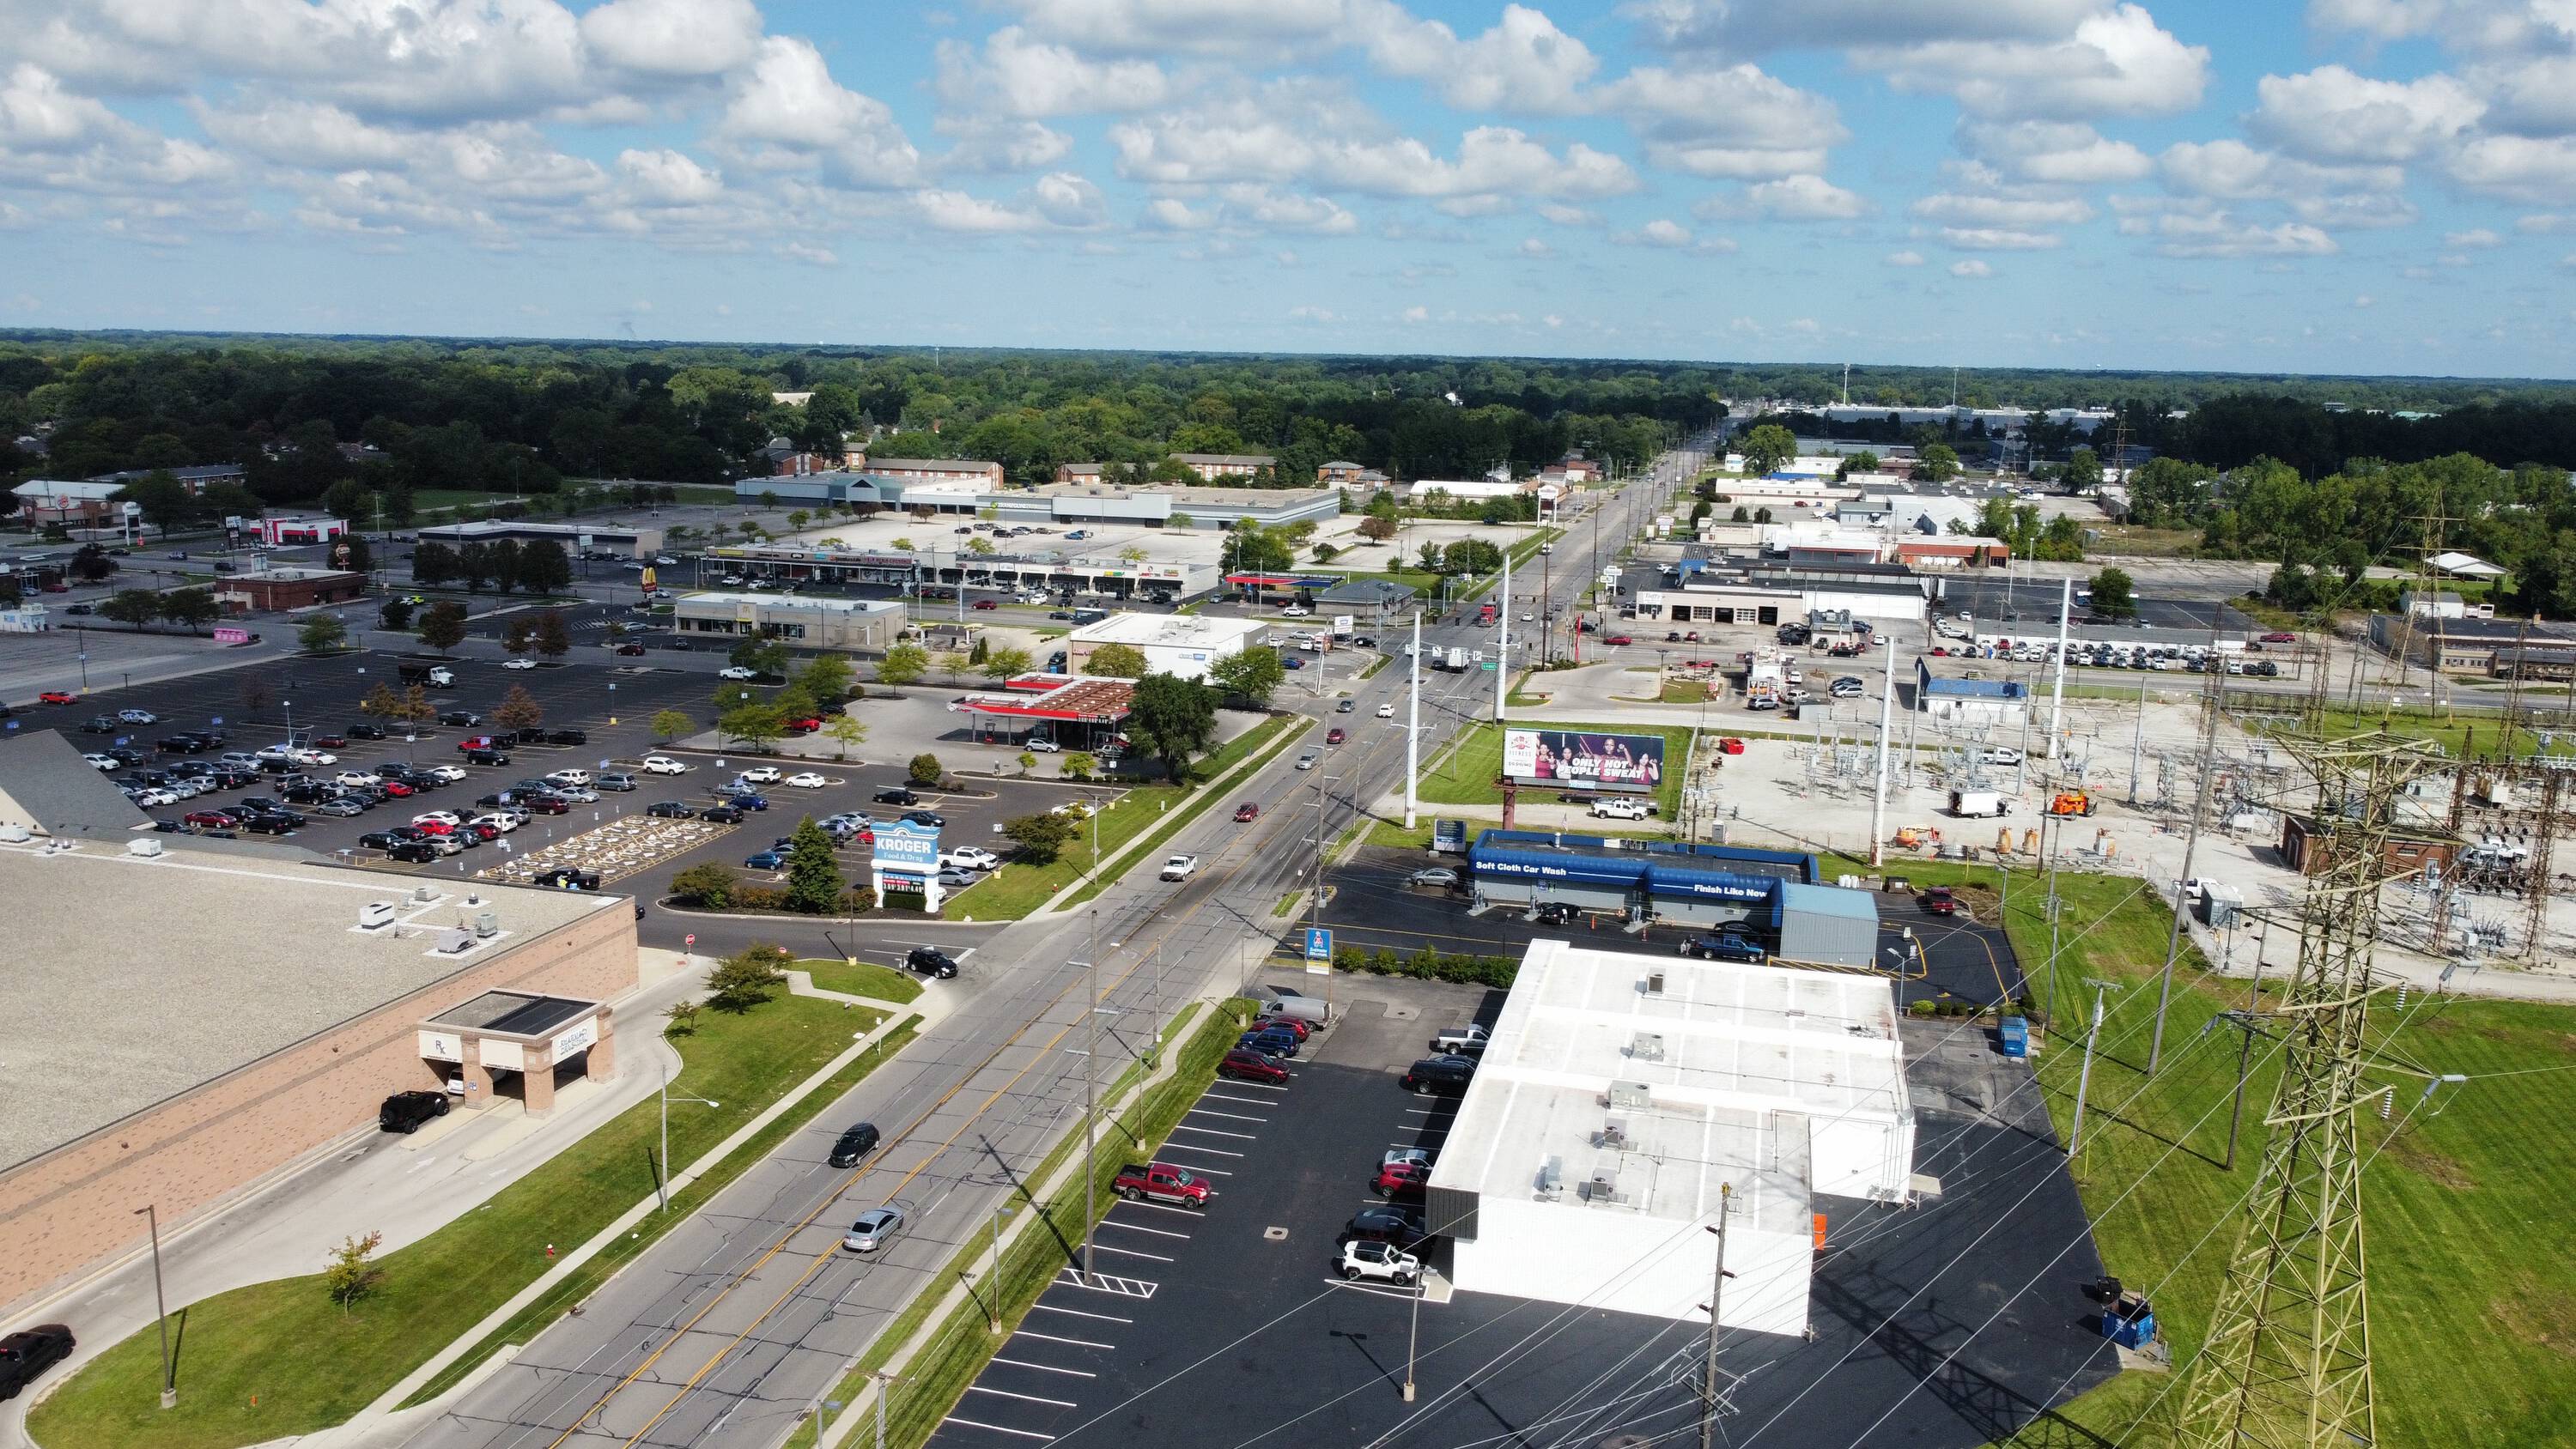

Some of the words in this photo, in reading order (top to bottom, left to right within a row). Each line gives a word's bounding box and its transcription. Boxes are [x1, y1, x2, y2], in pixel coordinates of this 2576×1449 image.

[1572, 757, 1601, 767] ONLY
[1604, 759, 1628, 769] HOT
[1558, 765, 1601, 776] PEOPLE
[1603, 768, 1643, 779] SWEAT
[876, 837, 931, 853] KROGER
[907, 853, 923, 863] Drug
[1475, 861, 1495, 870] Soft
[1498, 863, 1521, 872] Cloth
[1541, 866, 1566, 876] Wash
[1694, 884, 1722, 894] Finish
[1723, 887, 1744, 895] Like
[1746, 888, 1767, 898] New
